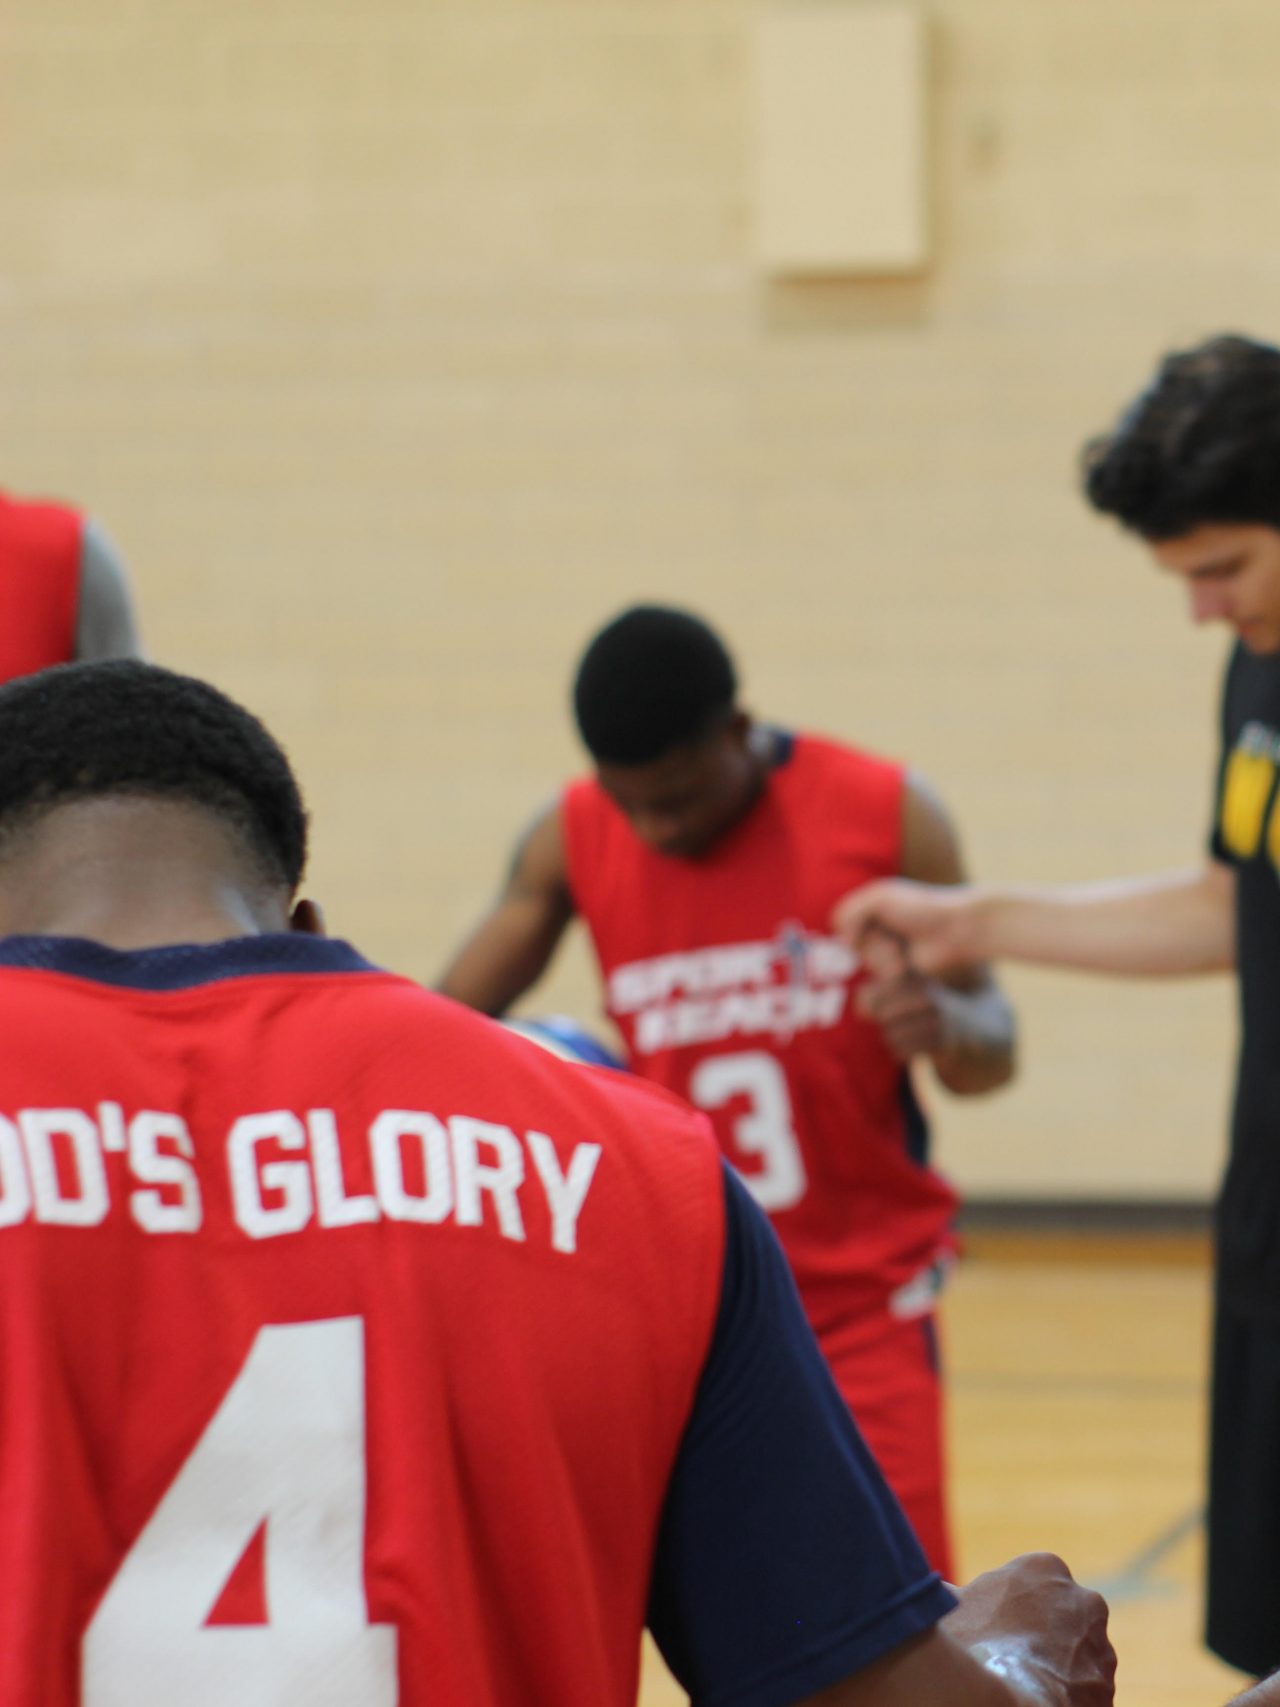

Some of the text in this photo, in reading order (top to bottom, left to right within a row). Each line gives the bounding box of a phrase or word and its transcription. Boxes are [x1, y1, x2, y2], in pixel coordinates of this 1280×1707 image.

[227, 1108, 602, 1254] GLORY
[690, 1050, 808, 1213] 3
[80, 1315, 399, 1707] 4
